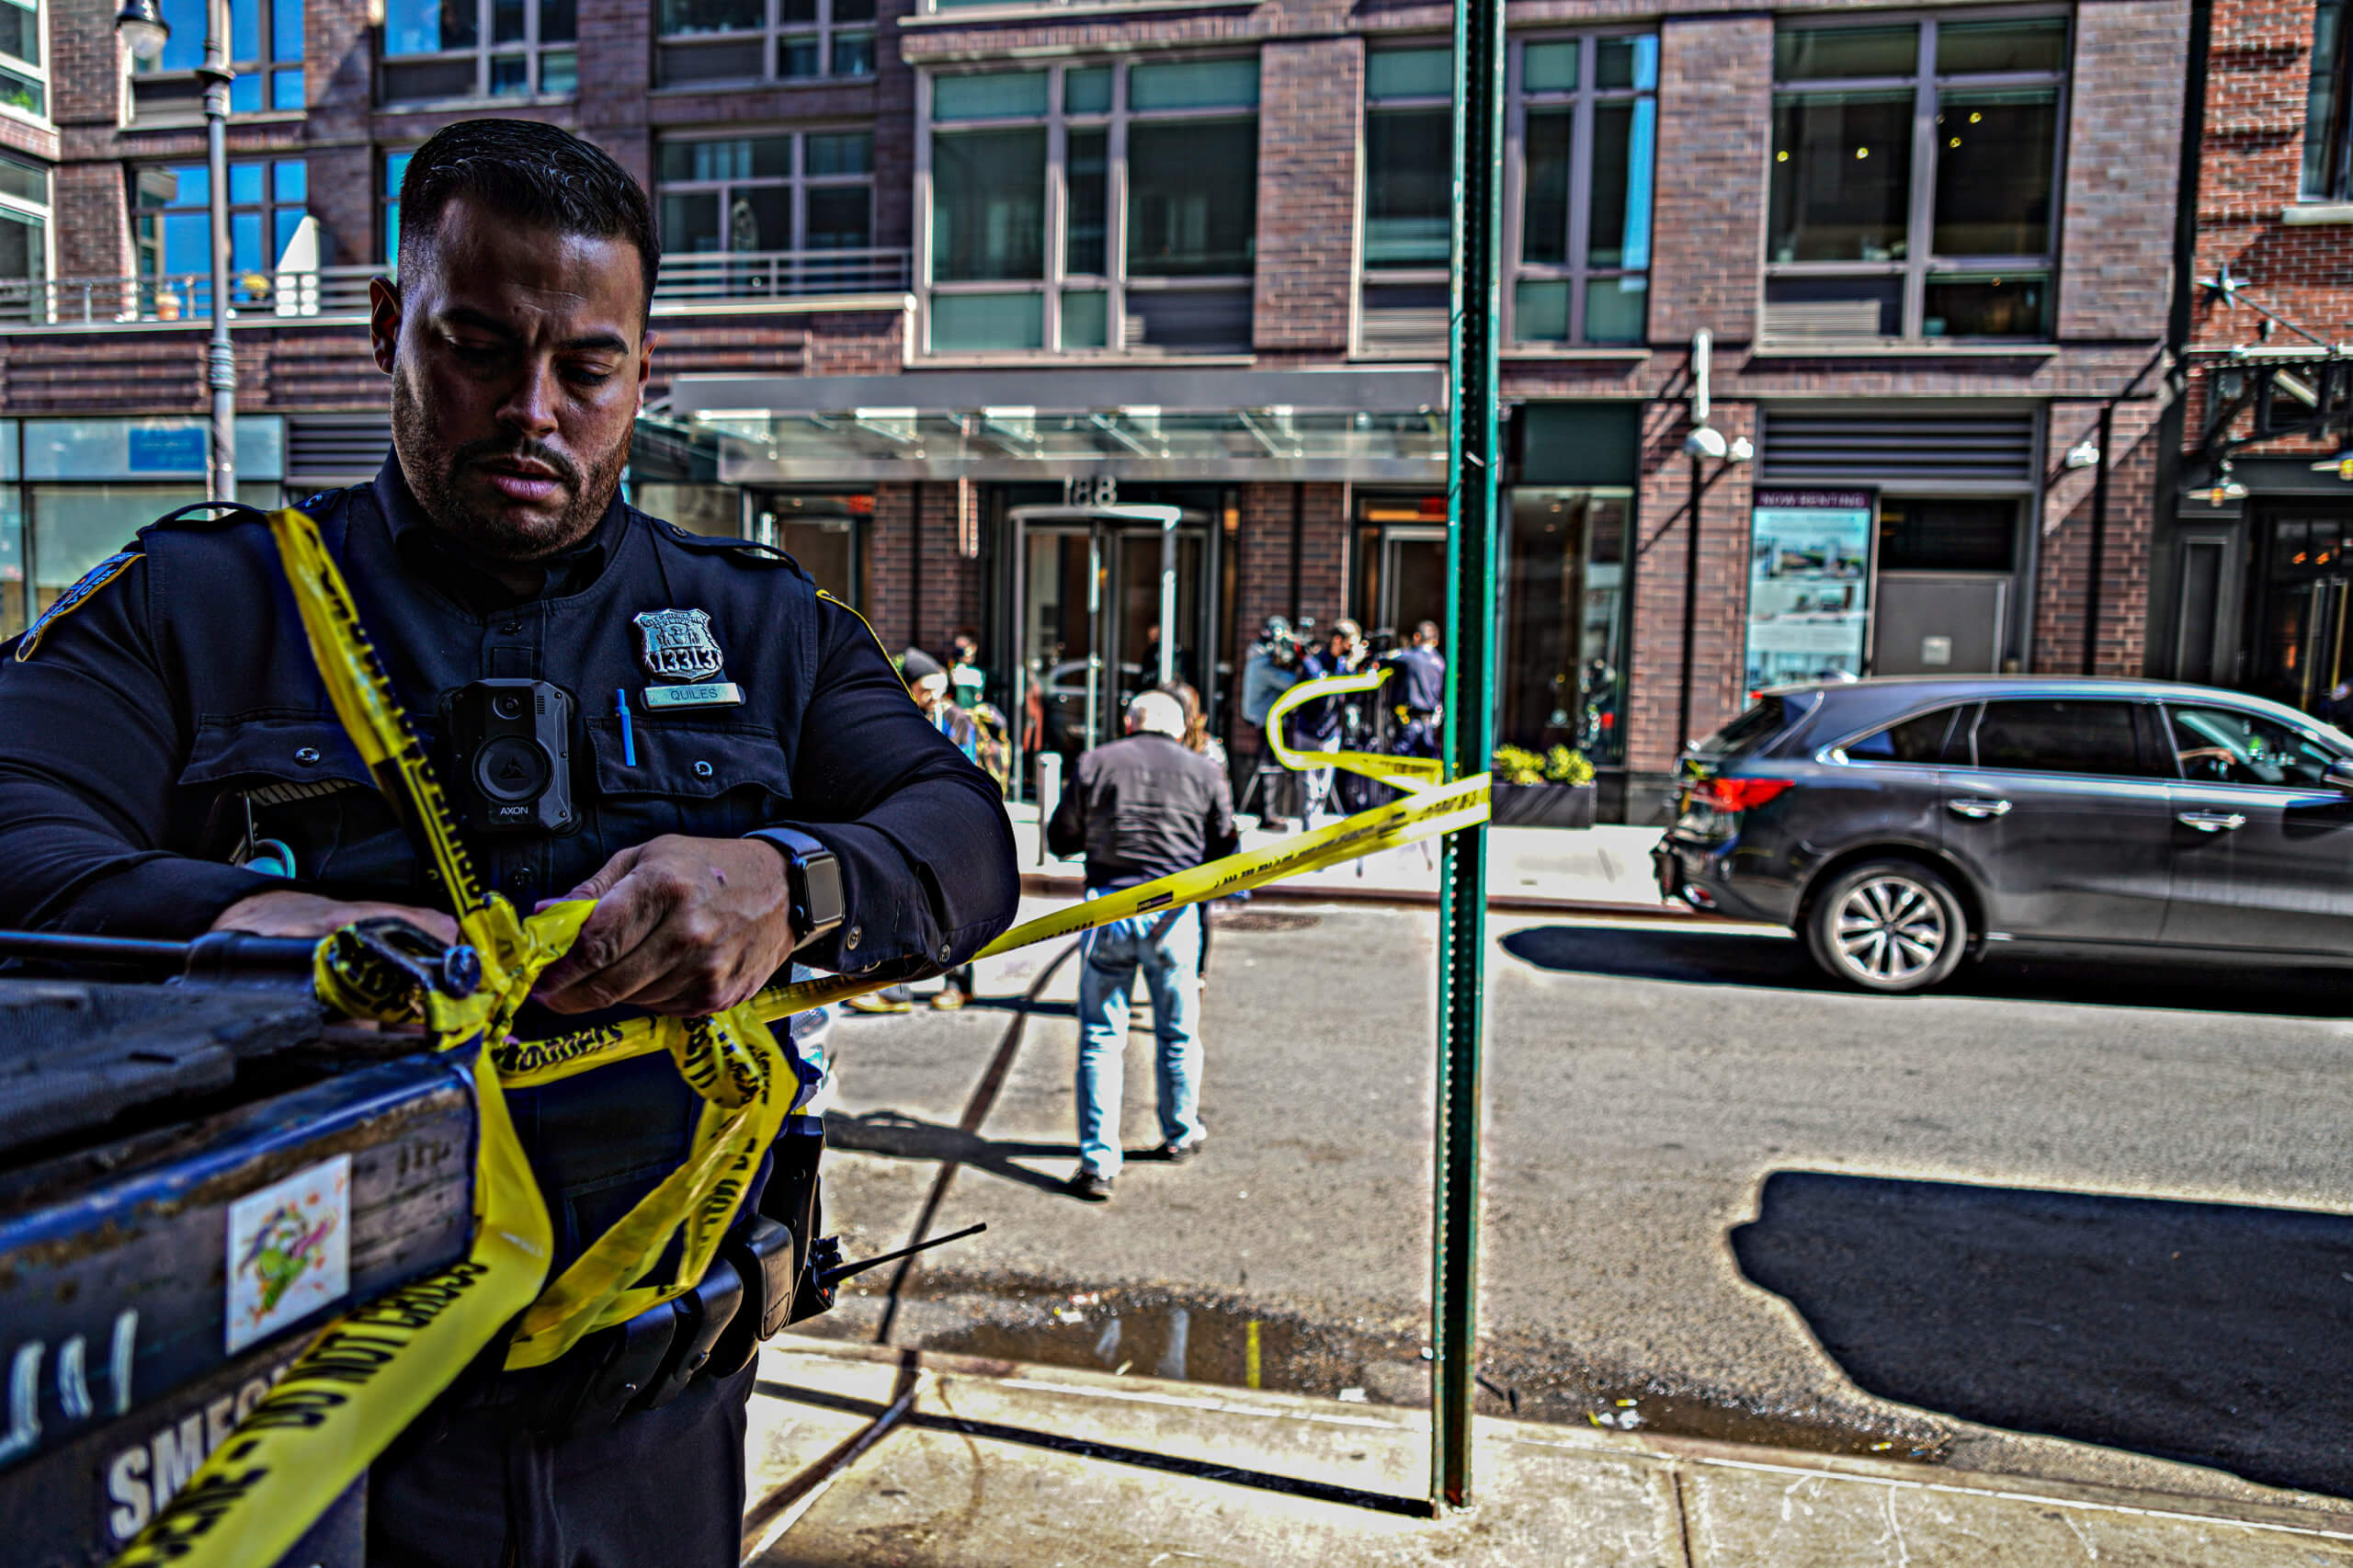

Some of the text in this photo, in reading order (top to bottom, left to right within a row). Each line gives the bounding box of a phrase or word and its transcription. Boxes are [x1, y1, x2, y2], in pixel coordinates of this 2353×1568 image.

[1063, 473, 1118, 507] 188
[654, 646, 717, 673] 13313
[670, 687, 719, 701] QUILES
[500, 806, 529, 815] AXON
